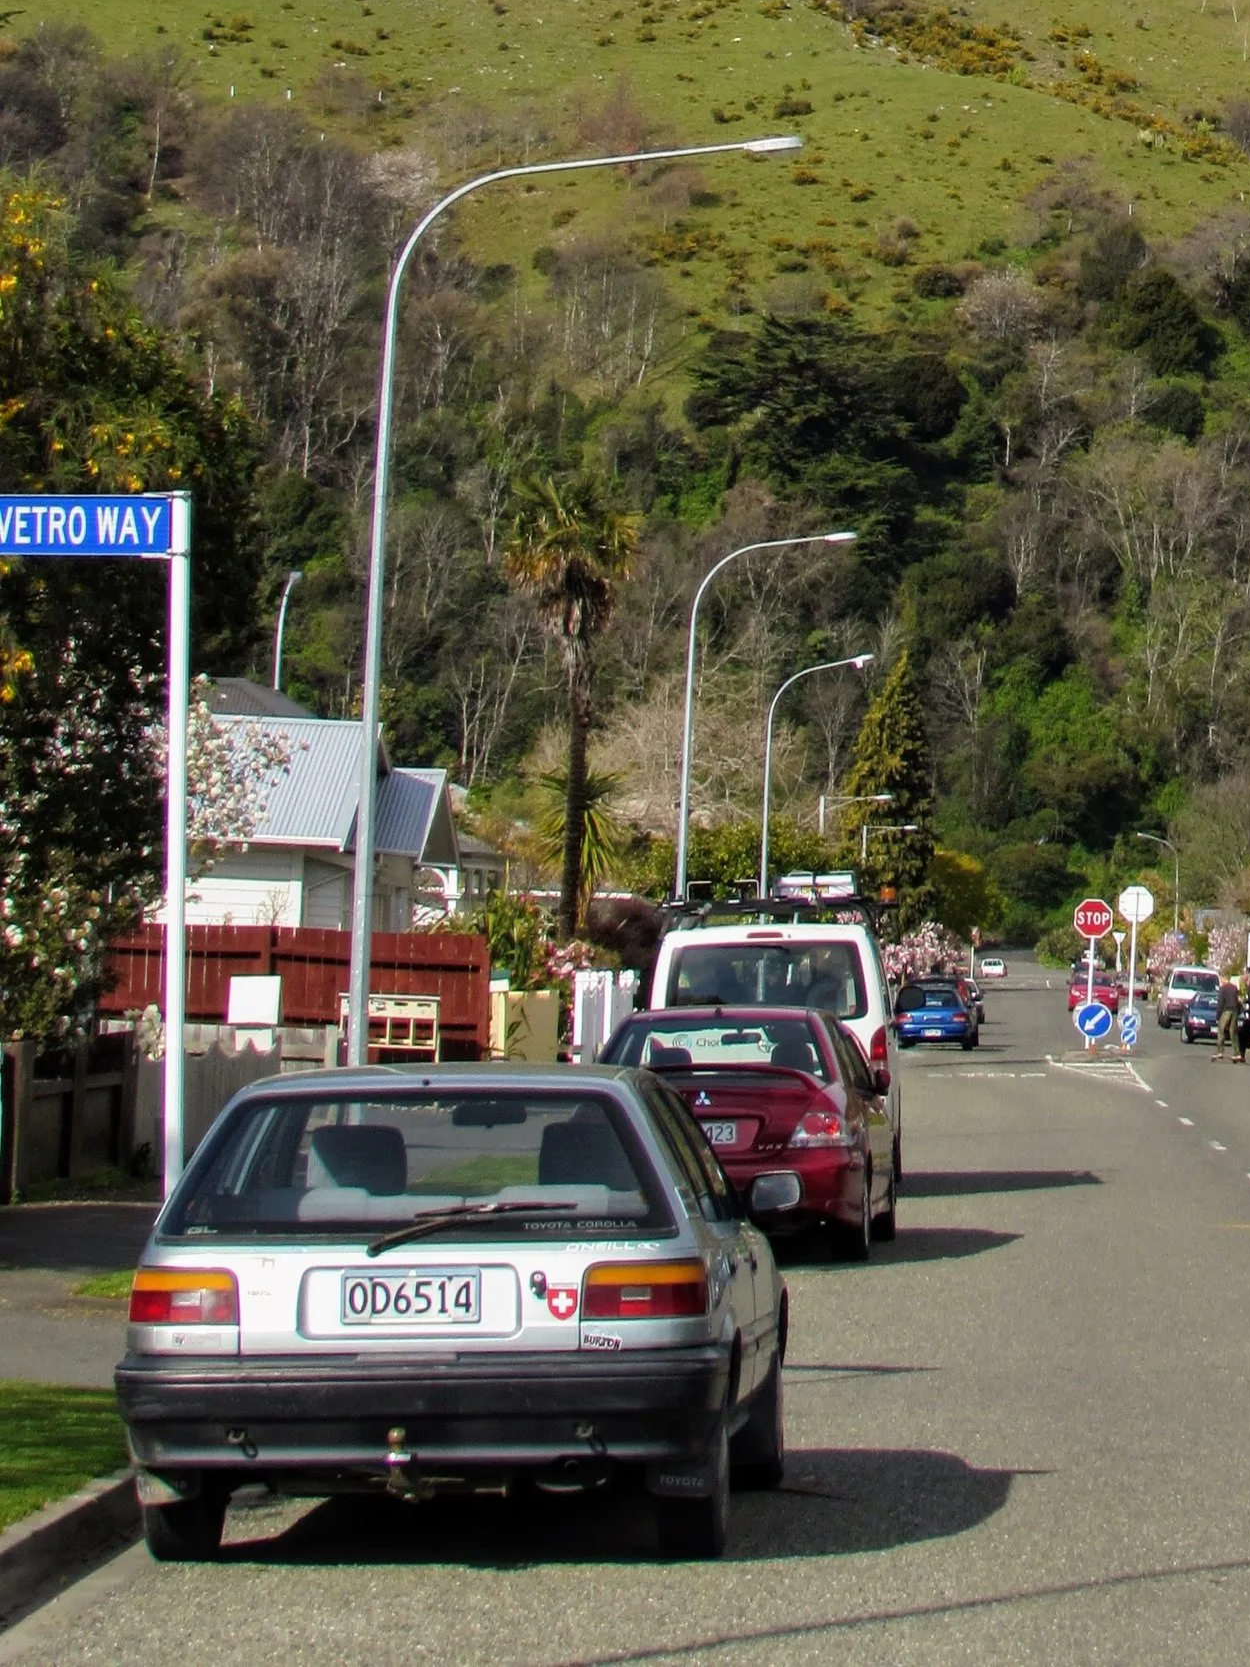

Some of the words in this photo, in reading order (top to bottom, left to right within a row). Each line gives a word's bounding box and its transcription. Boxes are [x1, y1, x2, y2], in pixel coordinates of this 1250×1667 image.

[0, 506, 87, 544] VETRO
[97, 506, 162, 544] WAY
[1077, 911, 1110, 926] STOP
[523, 1220, 573, 1230] TOYOTA
[577, 1219, 638, 1229] COROLLA
[583, 1333, 622, 1351] BURTON
